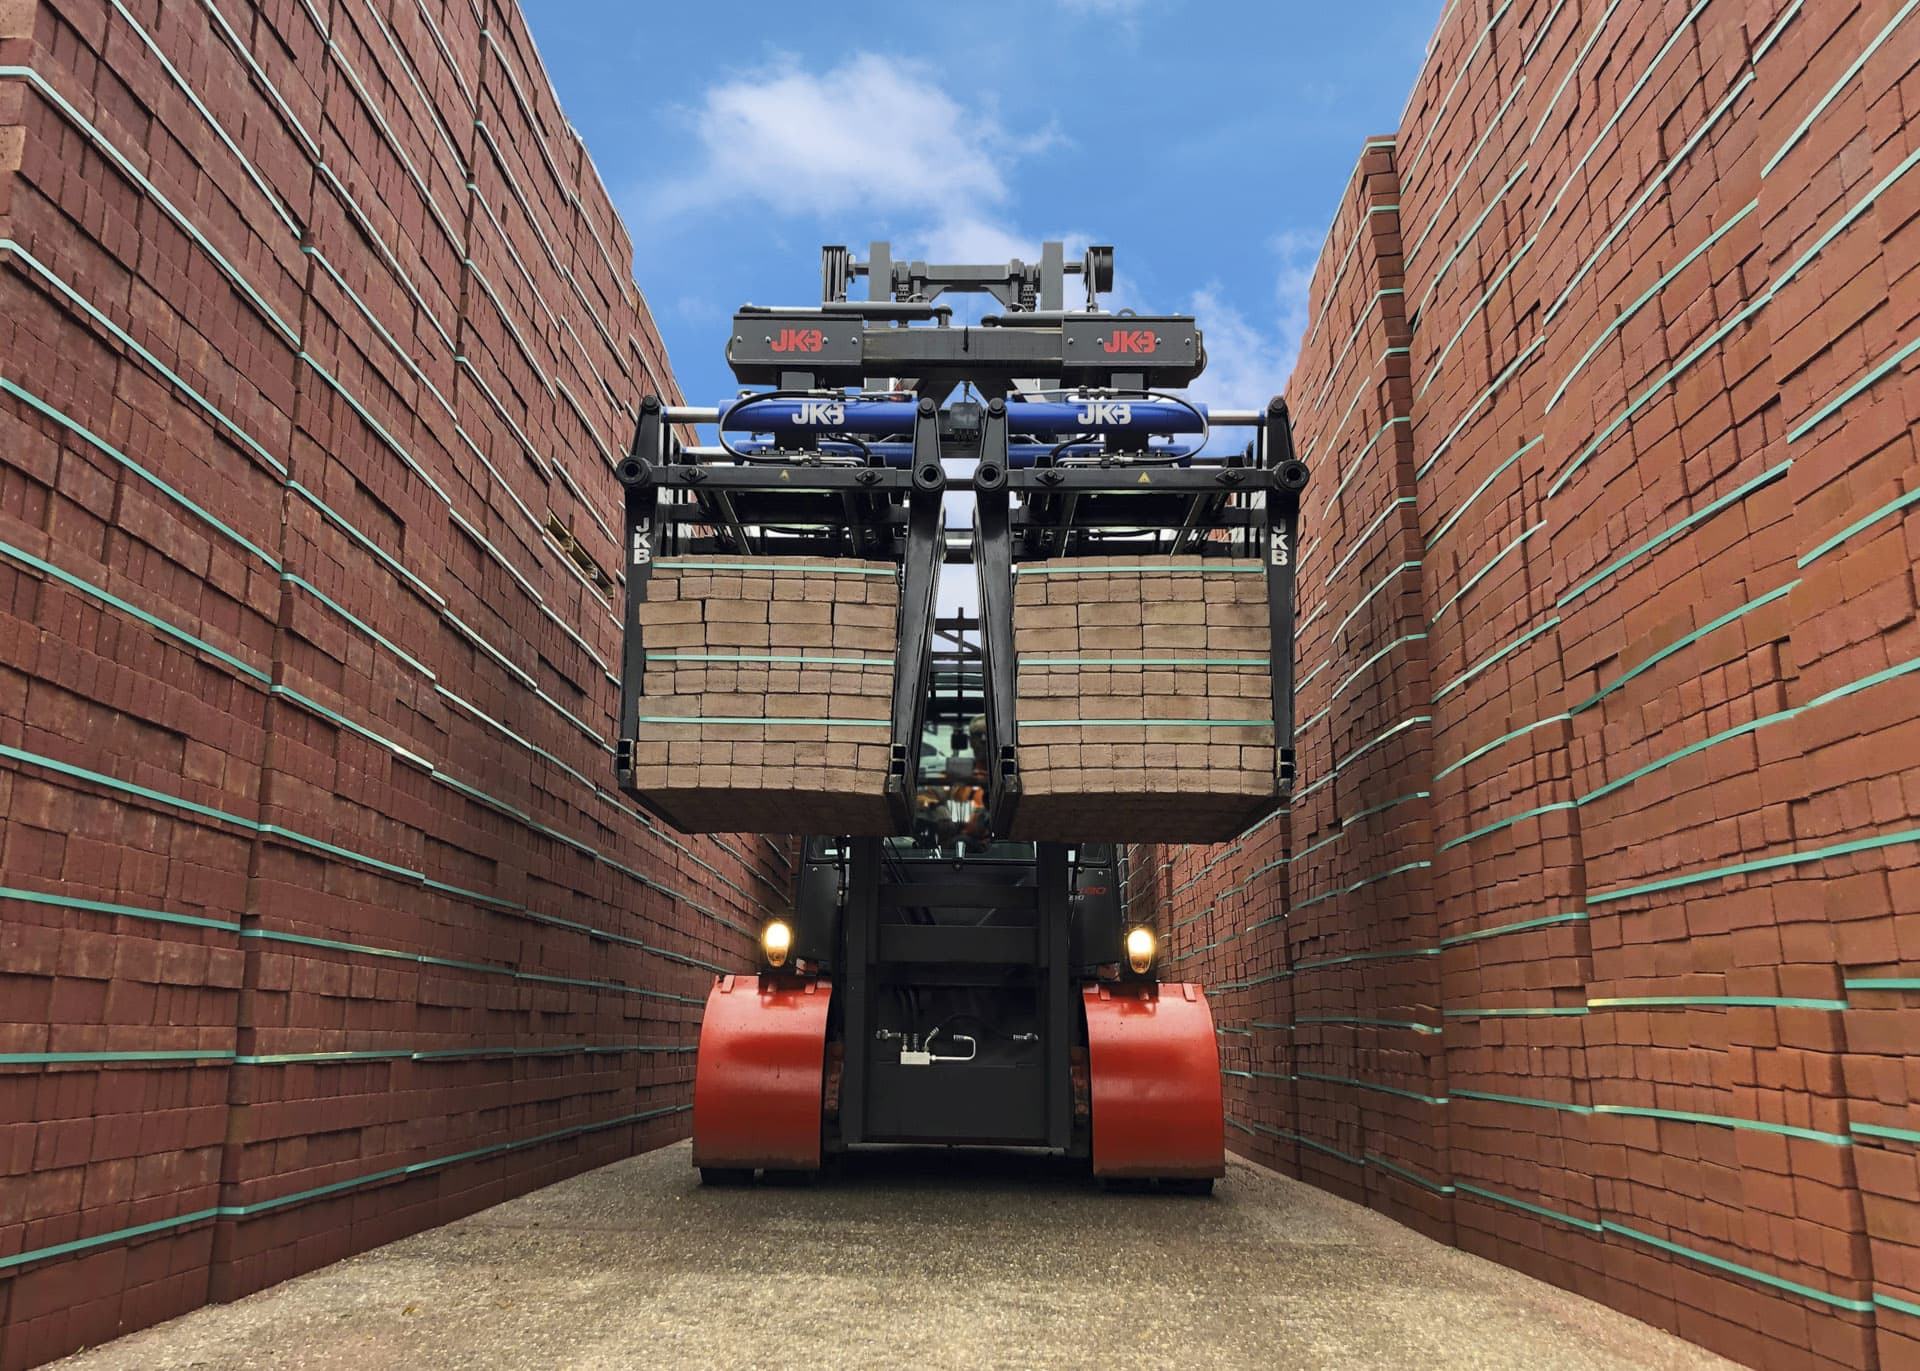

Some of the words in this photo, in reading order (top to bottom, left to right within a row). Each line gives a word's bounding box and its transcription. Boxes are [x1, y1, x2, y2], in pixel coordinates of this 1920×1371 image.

[771, 329, 823, 352] JKB
[1103, 330, 1156, 353] JKB
[791, 402, 845, 425] JKB
[1077, 402, 1132, 425] JKB
[633, 517, 651, 565] JKB
[1271, 518, 1289, 566] JKB
